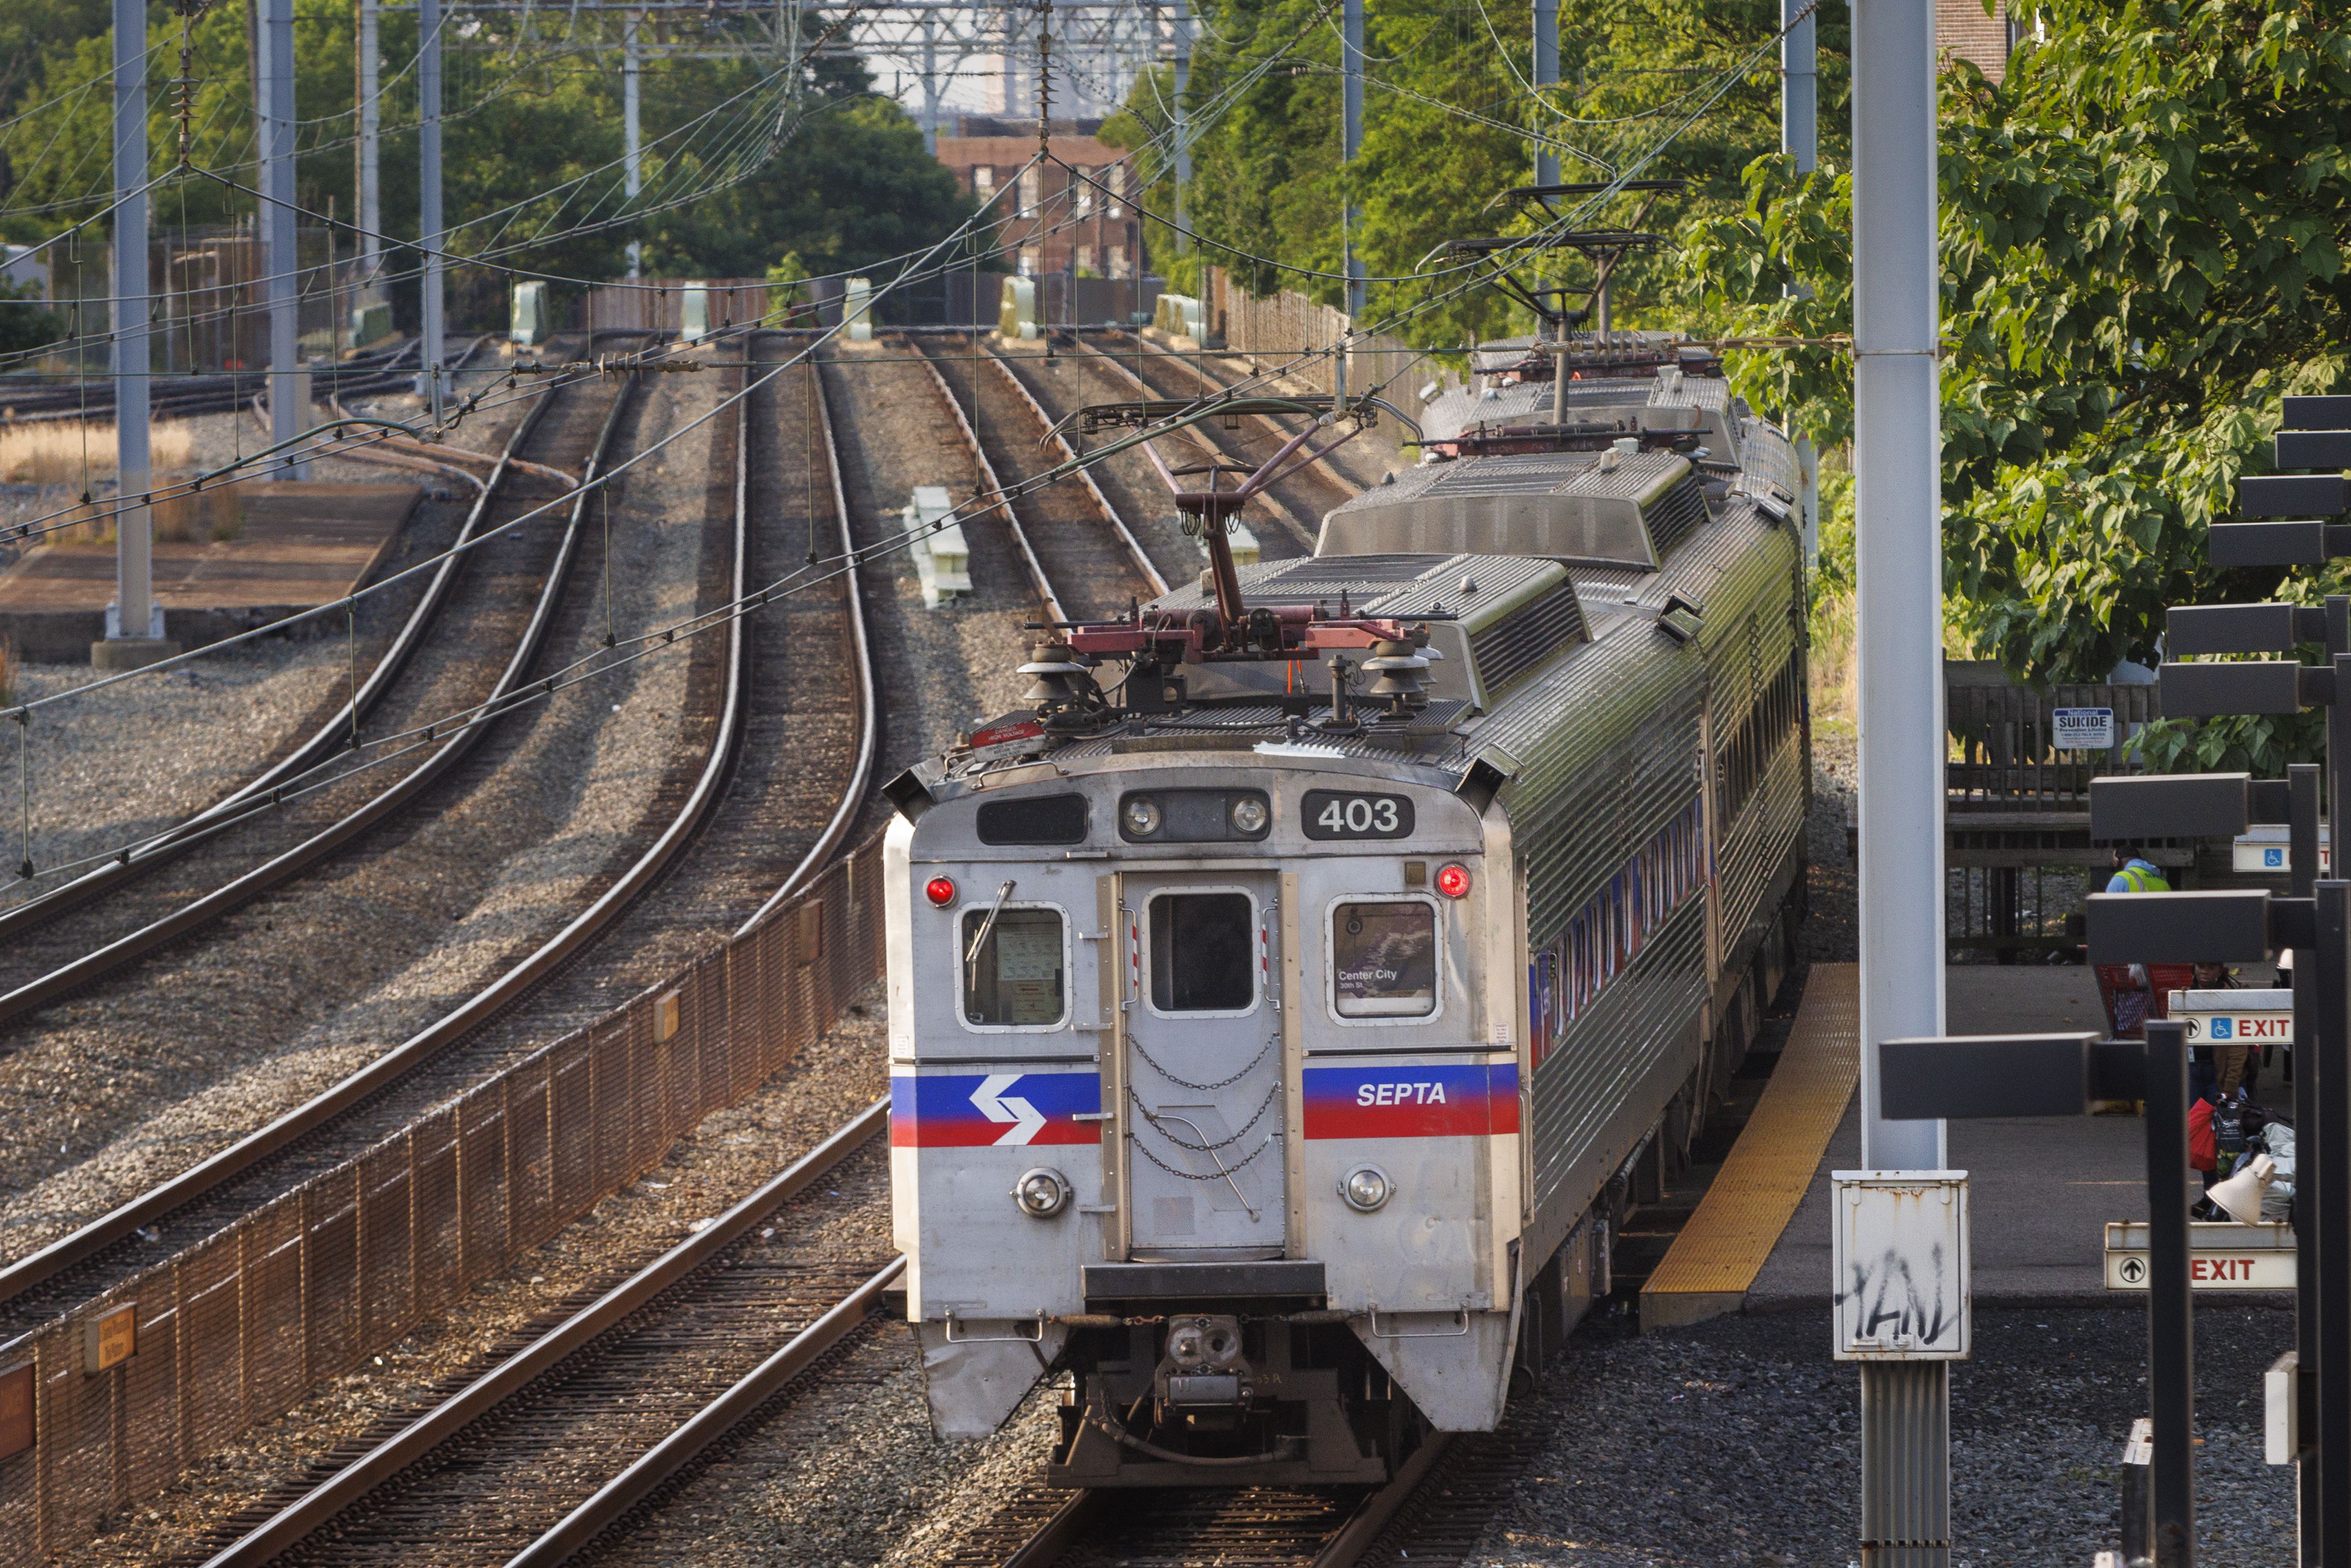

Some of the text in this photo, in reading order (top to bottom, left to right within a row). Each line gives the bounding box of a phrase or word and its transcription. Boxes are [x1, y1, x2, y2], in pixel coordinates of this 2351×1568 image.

[2059, 716, 2107, 728] SUICIDE
[995, 726, 1017, 734] DANGER
[1002, 729, 1025, 738] VOLTAGE
[1318, 799, 1399, 832] 403
[1339, 969, 1397, 981] Center City
[2238, 1019, 2290, 1036] EXIT
[1356, 1082, 1446, 1106] SEPTA
[2191, 1259, 2255, 1280] EXIT
